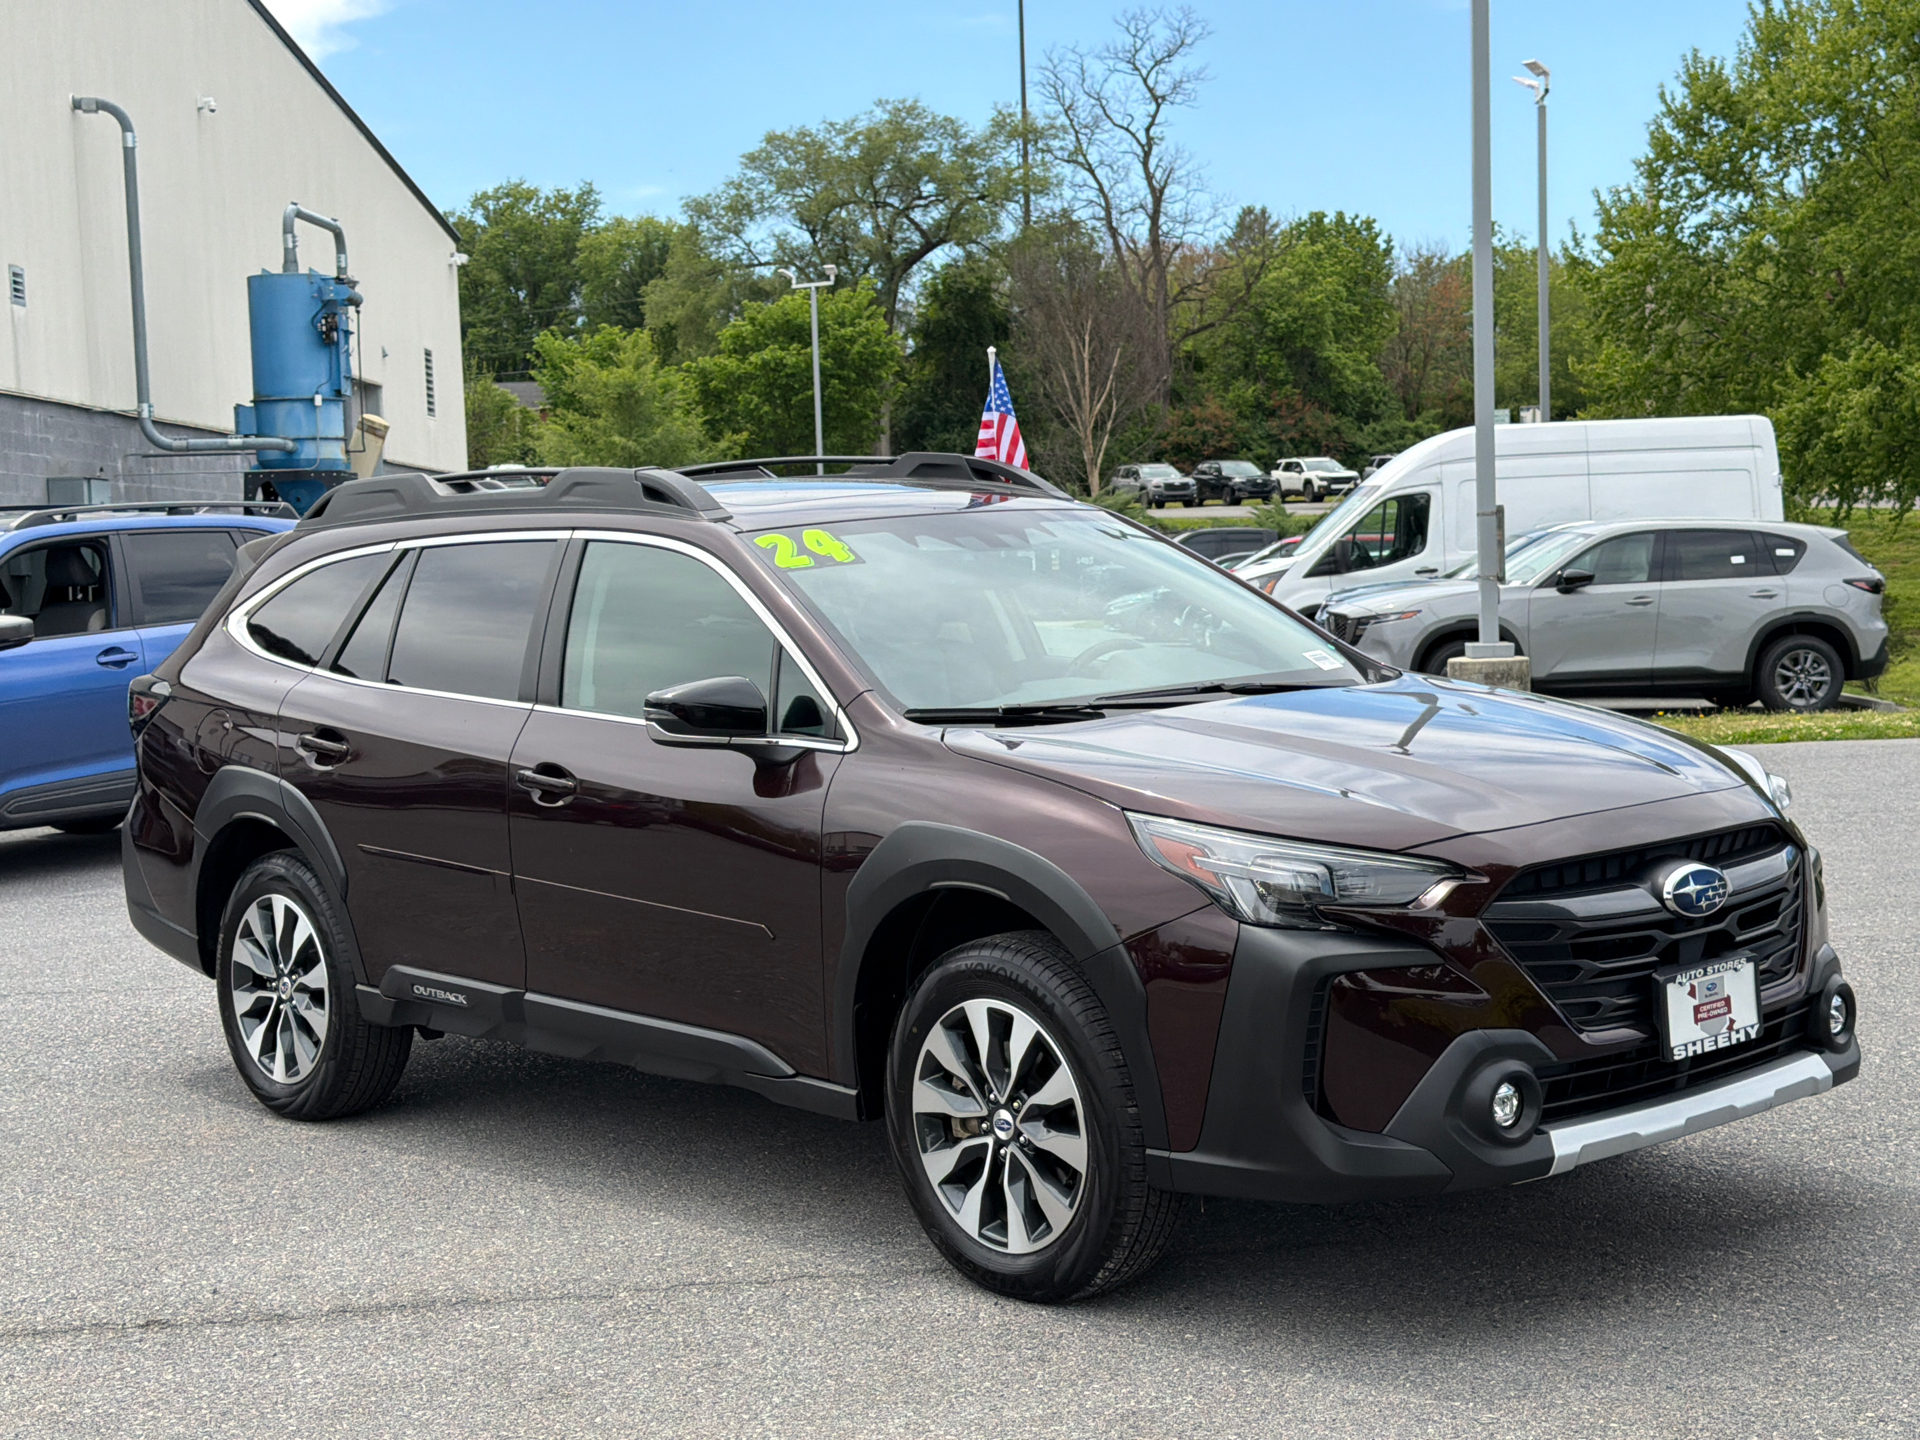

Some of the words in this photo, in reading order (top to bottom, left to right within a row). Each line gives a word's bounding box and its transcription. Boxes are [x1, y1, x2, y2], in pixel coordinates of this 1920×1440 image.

[753, 529, 856, 569] 24
[1675, 969, 1704, 984] AUTO
[1706, 958, 1747, 975] STORES
[413, 984, 467, 1005] OUTBACK
[1699, 1000, 1726, 1012] CERTIFIED
[1697, 1006, 1728, 1020] PRE-OWNED
[1673, 1024, 1760, 1060] SHEEHY
